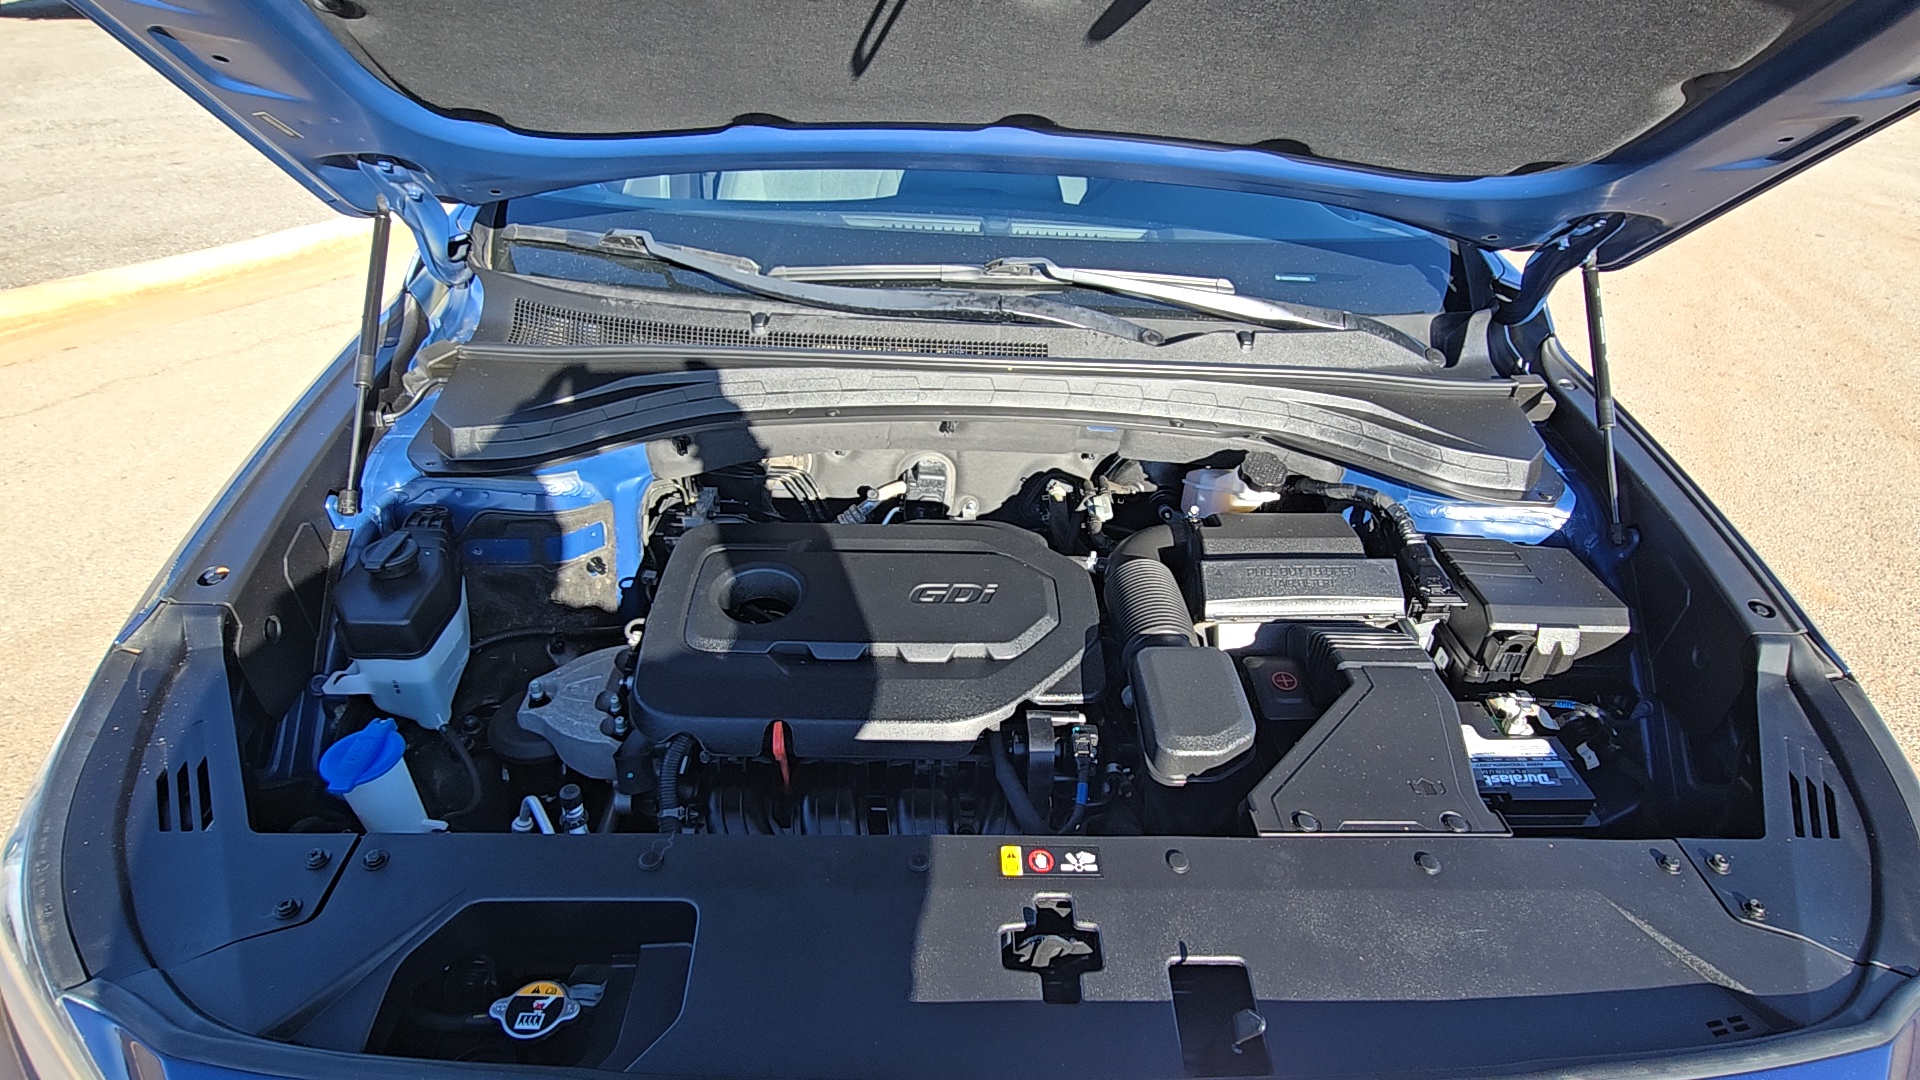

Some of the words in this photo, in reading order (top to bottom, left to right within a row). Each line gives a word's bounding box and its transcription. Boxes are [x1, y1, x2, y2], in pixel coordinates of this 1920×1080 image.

[1280, 565, 1304, 577] OUT
[909, 583, 998, 604] GDi
[1483, 773, 1556, 786] Duralast
